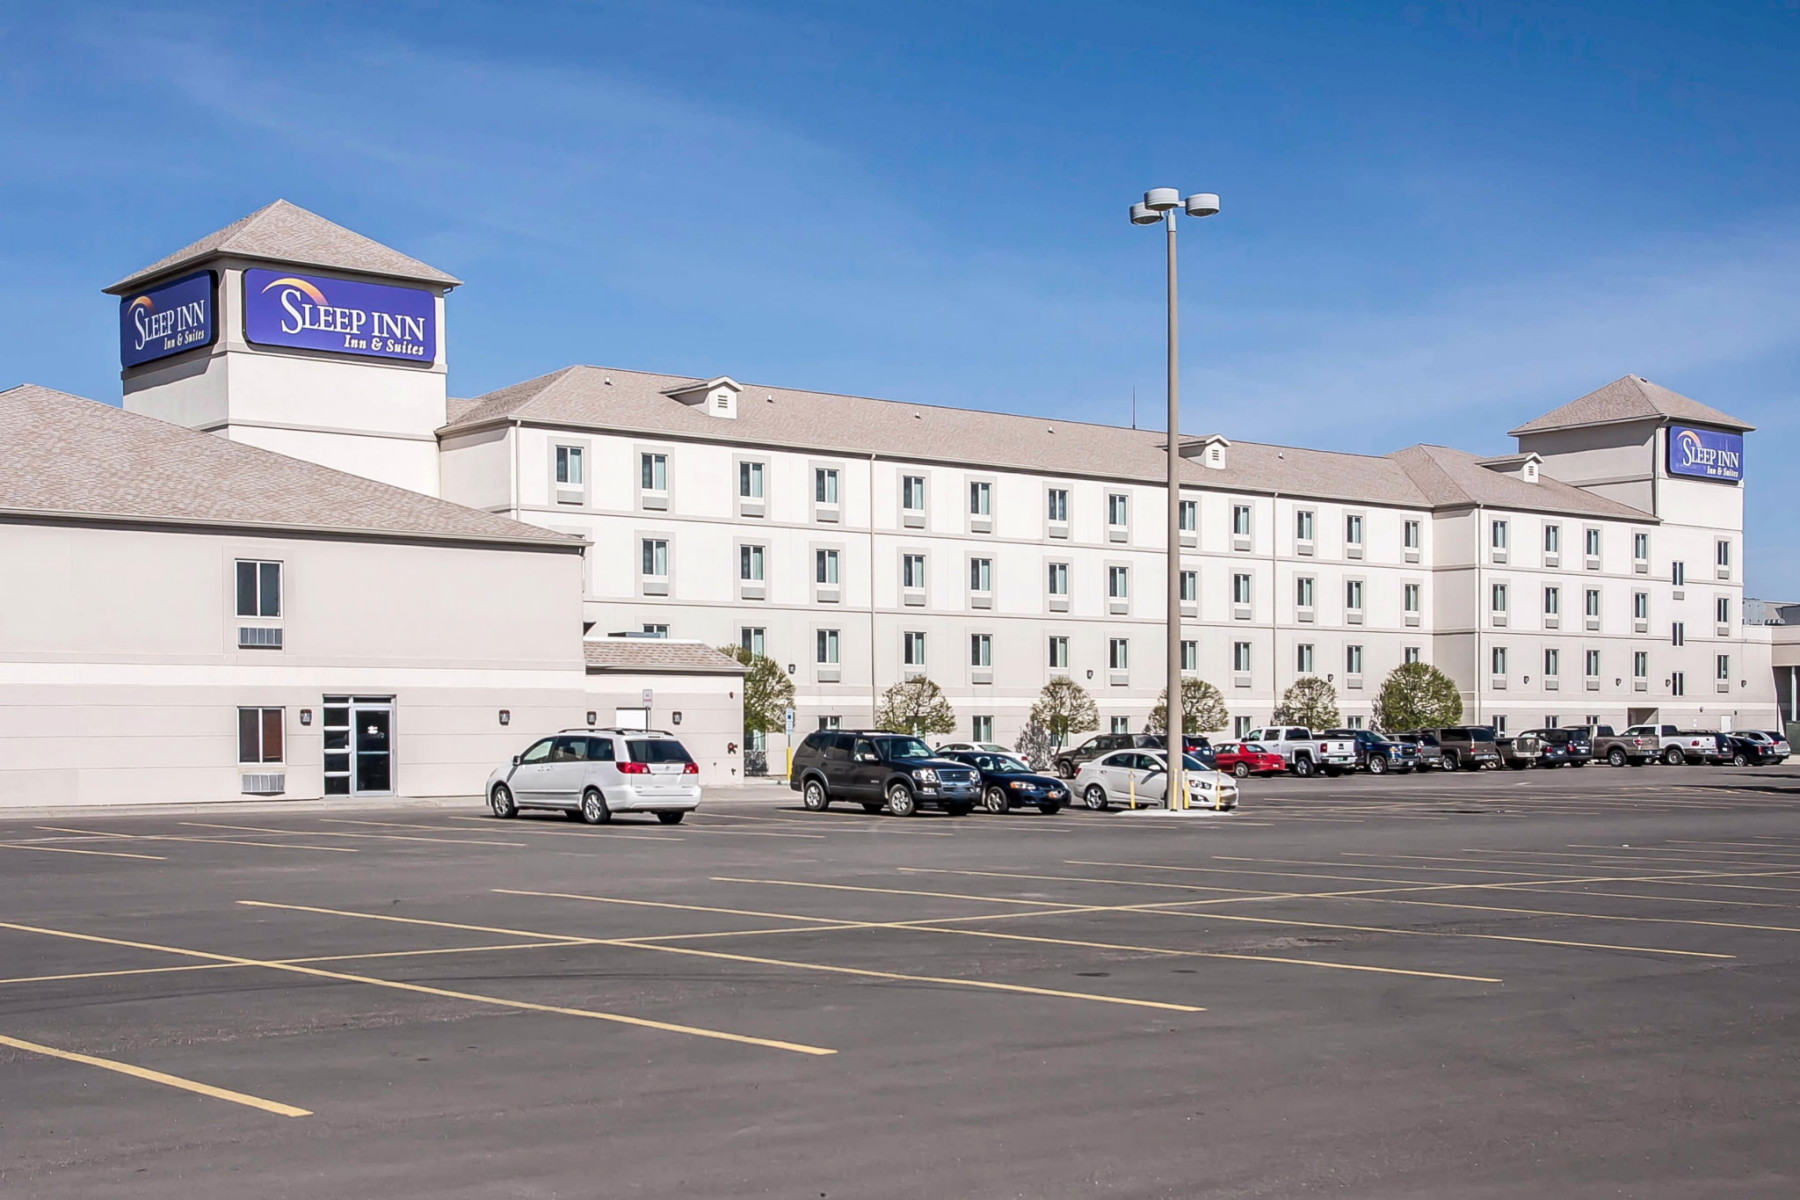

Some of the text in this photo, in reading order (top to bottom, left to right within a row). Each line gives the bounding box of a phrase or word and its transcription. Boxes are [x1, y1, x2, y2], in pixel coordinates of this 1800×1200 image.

[134, 299, 205, 350] SLEEP INN
[280, 288, 426, 342] SLEEP INN
[164, 330, 205, 350] Inn & Suites
[344, 336, 424, 356] Inn & Suites
[1682, 437, 1740, 468] SLEEP INN
